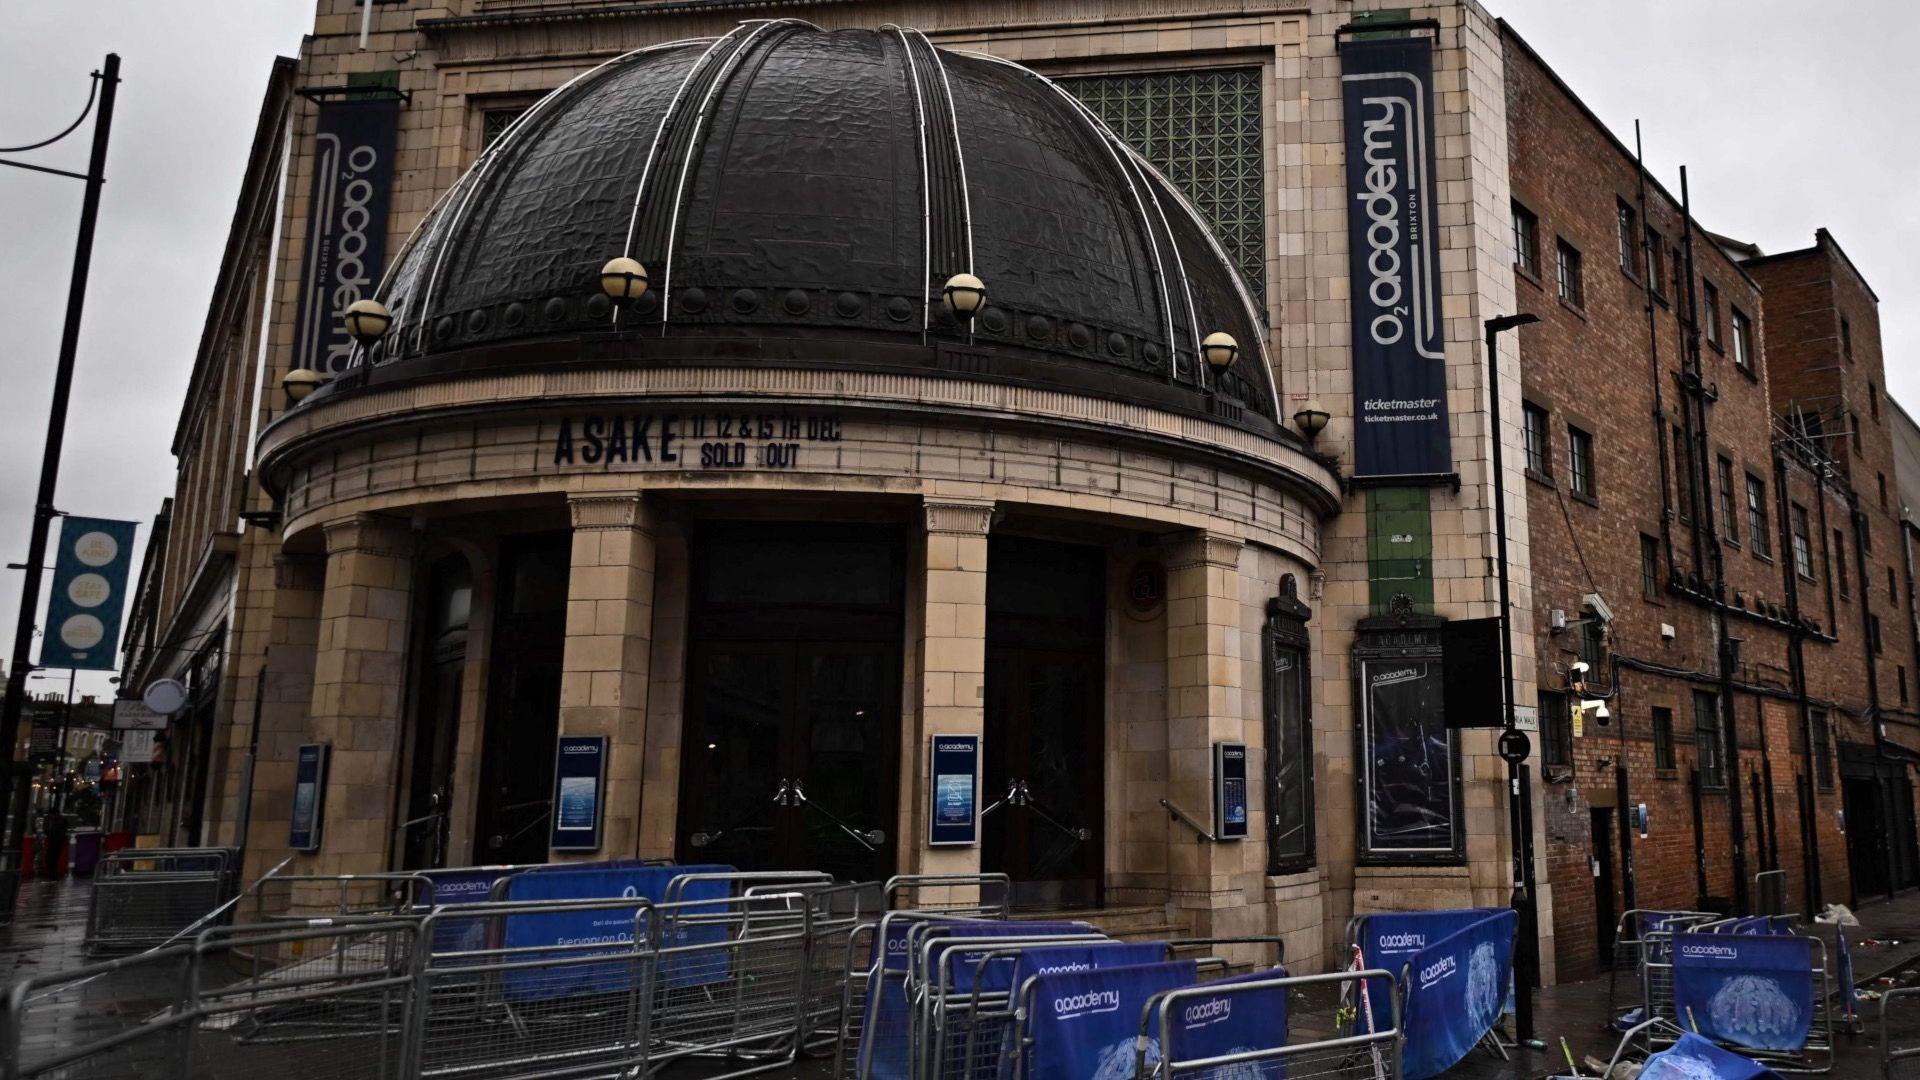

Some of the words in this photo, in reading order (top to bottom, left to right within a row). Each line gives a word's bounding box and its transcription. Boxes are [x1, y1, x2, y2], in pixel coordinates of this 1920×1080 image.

[1410, 194, 1418, 240] BRIXTON
[319, 239, 330, 283] BRIXTON
[1364, 398, 1438, 410] ticketmaster
[1364, 412, 1438, 422] ticketmaster.co.uk
[554, 415, 677, 465] ASAKE
[691, 415, 704, 438] 11
[716, 415, 733, 438] 12
[739, 415, 752, 439] &
[807, 415, 841, 441] DEC
[701, 442, 745, 467] SOLD
[767, 443, 800, 467] OUT
